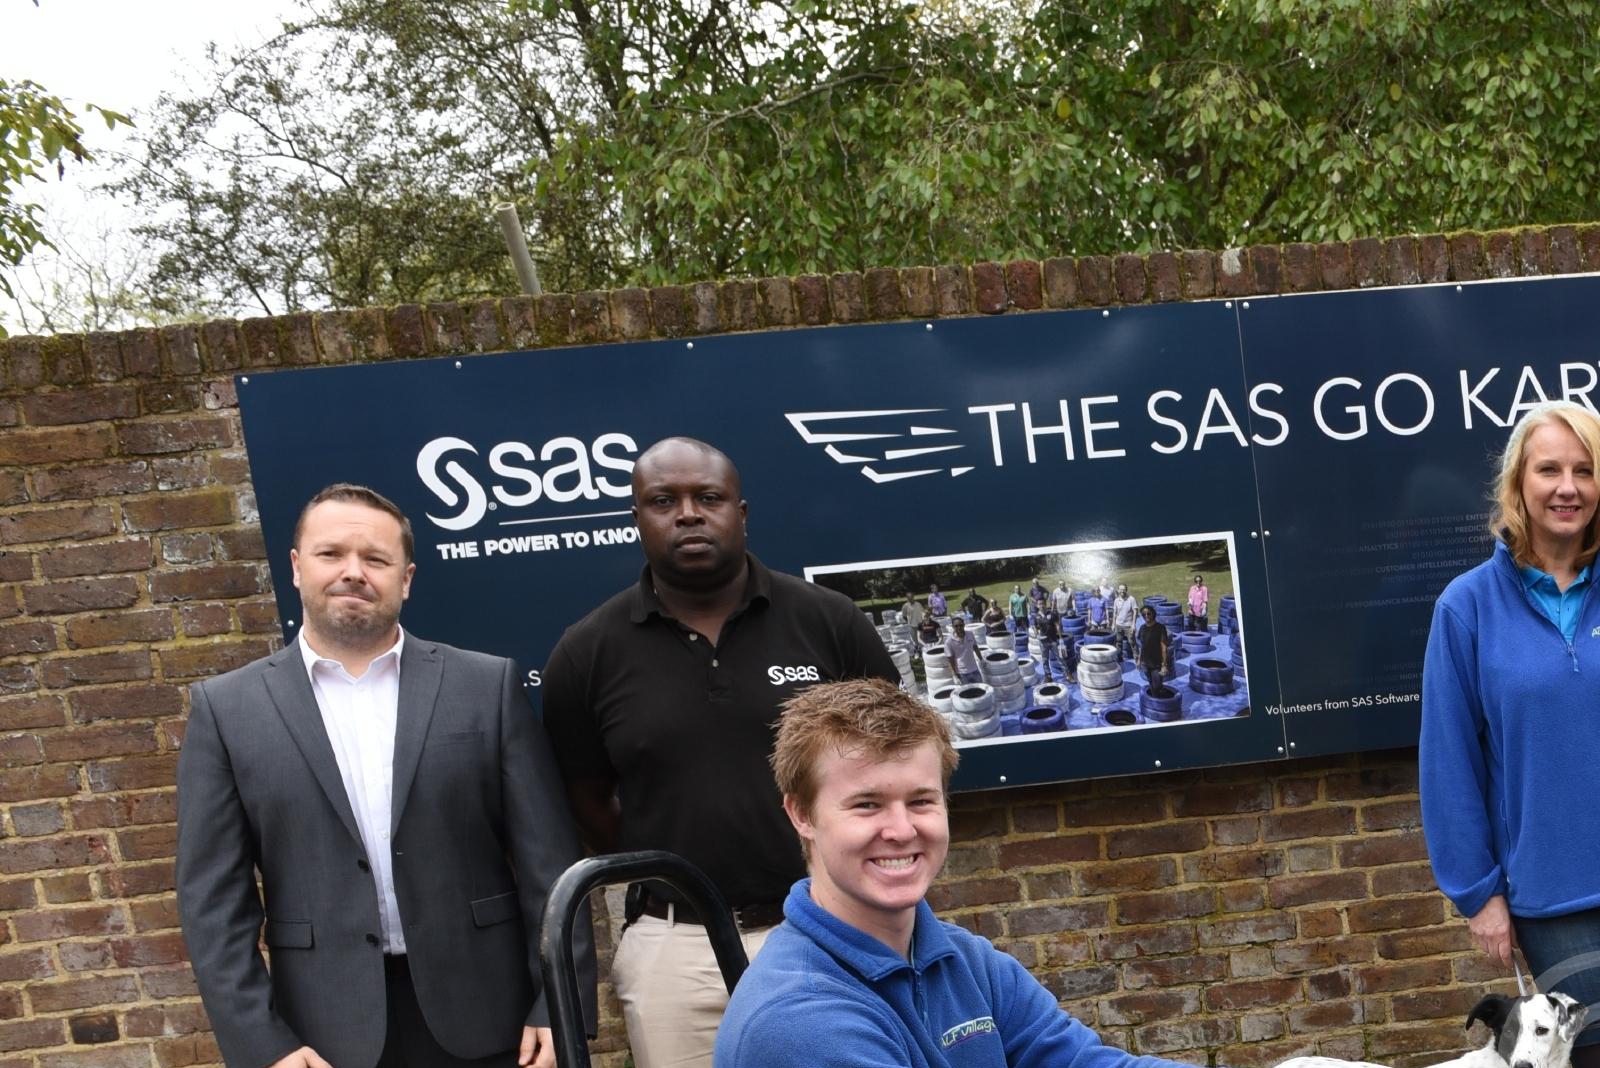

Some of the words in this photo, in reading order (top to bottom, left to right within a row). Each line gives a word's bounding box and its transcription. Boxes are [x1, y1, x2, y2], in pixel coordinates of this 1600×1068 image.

[968, 394, 1126, 466] THE
[1147, 382, 1290, 455] SAS
[1313, 372, 1434, 442] GO
[437, 542, 480, 560] THE
[485, 534, 560, 556] POWER
[561, 531, 590, 549] TO
[593, 526, 642, 547] KNO
[1266, 704, 1323, 715] Volunteers
[1325, 699, 1349, 711] from
[1352, 695, 1374, 707] SAS
[1376, 692, 1420, 704] Software
